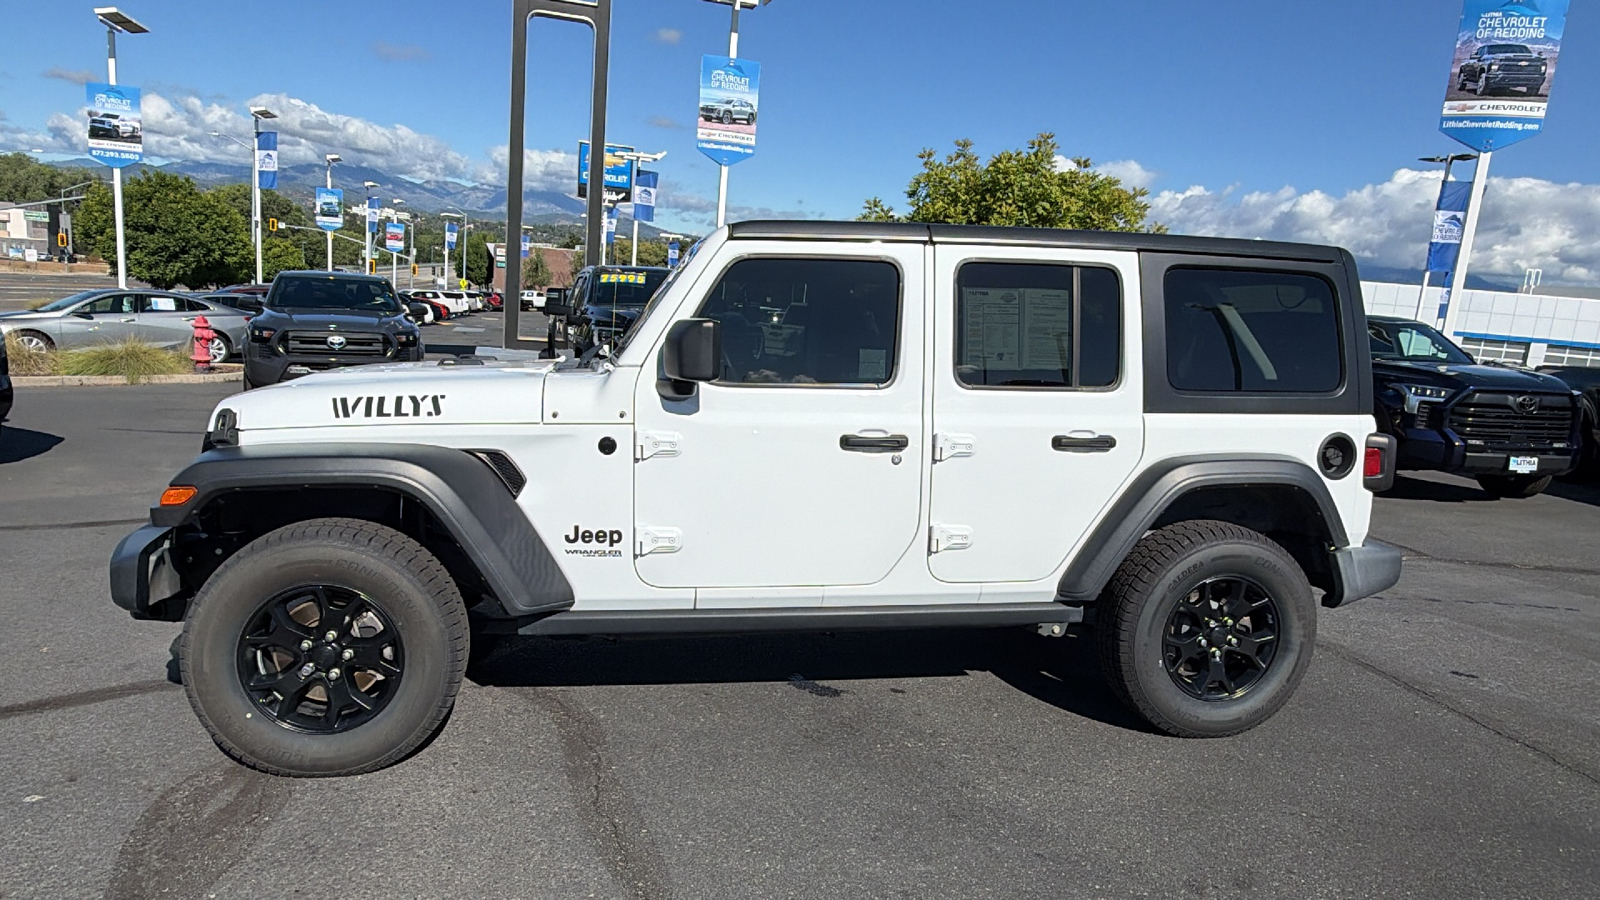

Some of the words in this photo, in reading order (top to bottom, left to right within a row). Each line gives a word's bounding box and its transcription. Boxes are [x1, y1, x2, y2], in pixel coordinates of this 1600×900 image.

[1478, 17, 1547, 28] CHEVROLET
[1476, 29, 1491, 39] OF
[1494, 28, 1545, 39] REDDING
[711, 73, 750, 85] CHEVROLET
[721, 82, 750, 92] REDDING
[95, 97, 131, 105] CHEVROLET
[104, 102, 131, 111] REDDING
[1479, 104, 1542, 113] CHEVROLET
[1442, 121, 1539, 131] LithiaChevroletRedding.com
[332, 395, 446, 418] WILLYS
[564, 525, 623, 547] Jeep
[1167, 561, 1205, 593] CALDERA
